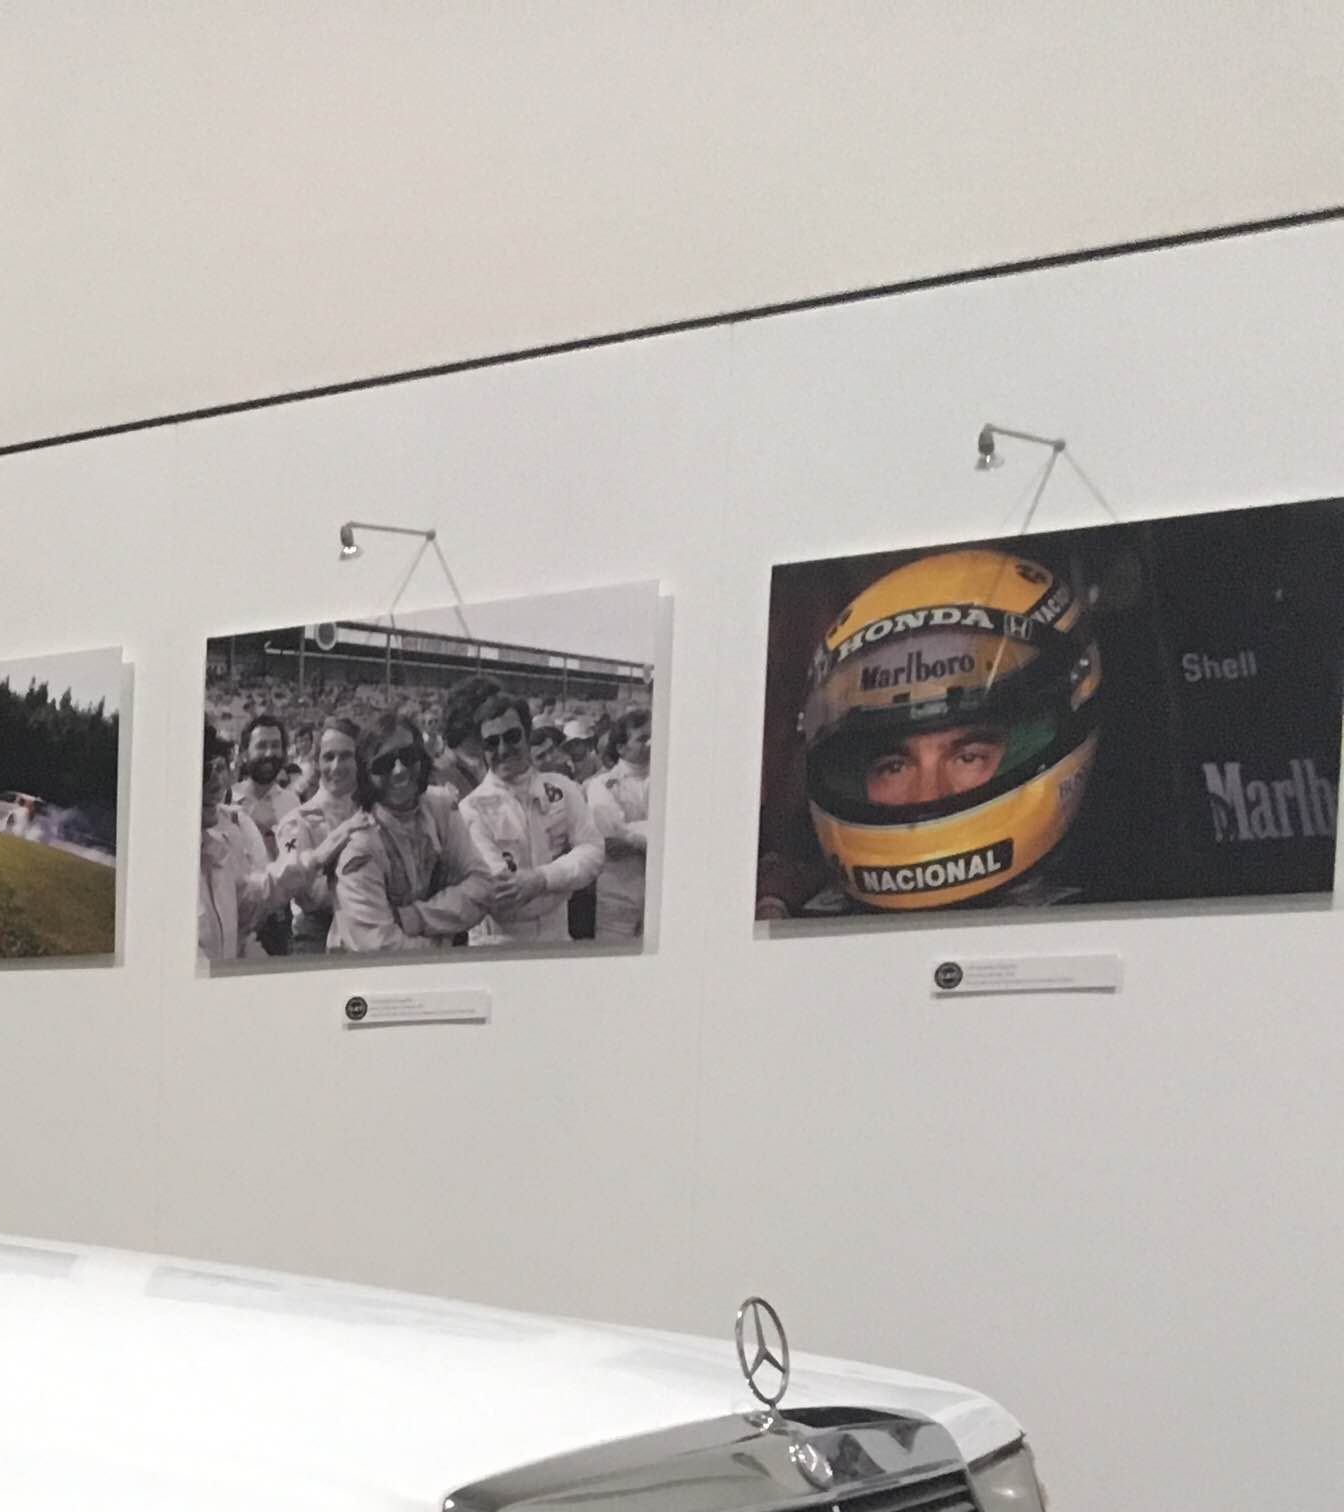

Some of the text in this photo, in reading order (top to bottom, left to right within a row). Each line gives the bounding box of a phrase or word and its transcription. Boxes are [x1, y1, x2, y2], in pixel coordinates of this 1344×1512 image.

[838, 607, 994, 662] HONDA
[860, 651, 976, 691] Marlboro
[1181, 650, 1258, 682] Shell
[862, 850, 1002, 893] NACIONAL
